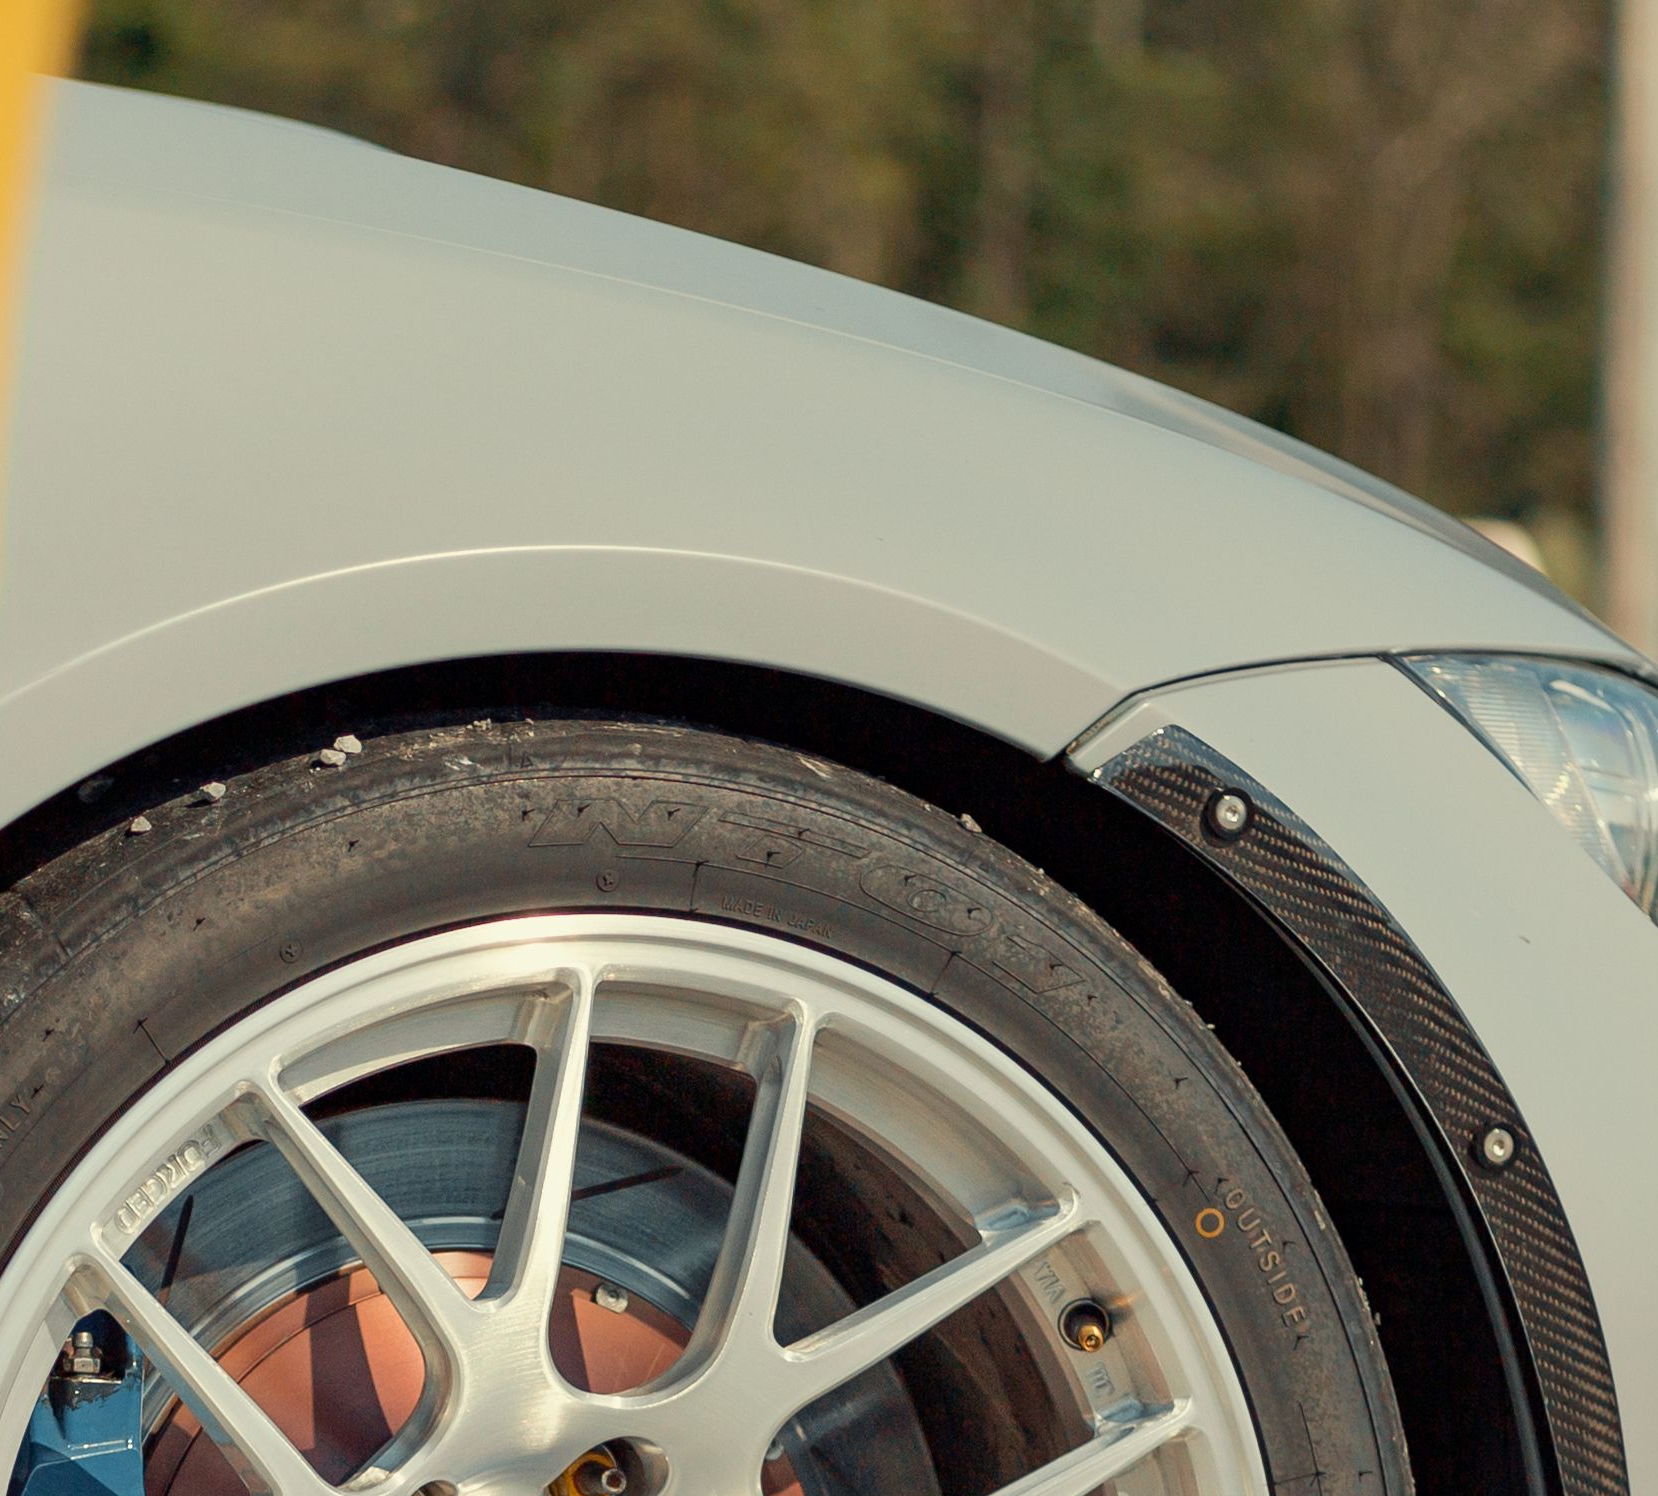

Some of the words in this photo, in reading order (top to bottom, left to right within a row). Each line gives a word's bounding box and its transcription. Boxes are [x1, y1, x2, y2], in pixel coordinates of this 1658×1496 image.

[719, 895, 763, 918] MADE
[766, 905, 782, 923] IN
[786, 911, 834, 940] JAPAN
[1223, 1186, 1307, 1328] OUTSIDE
